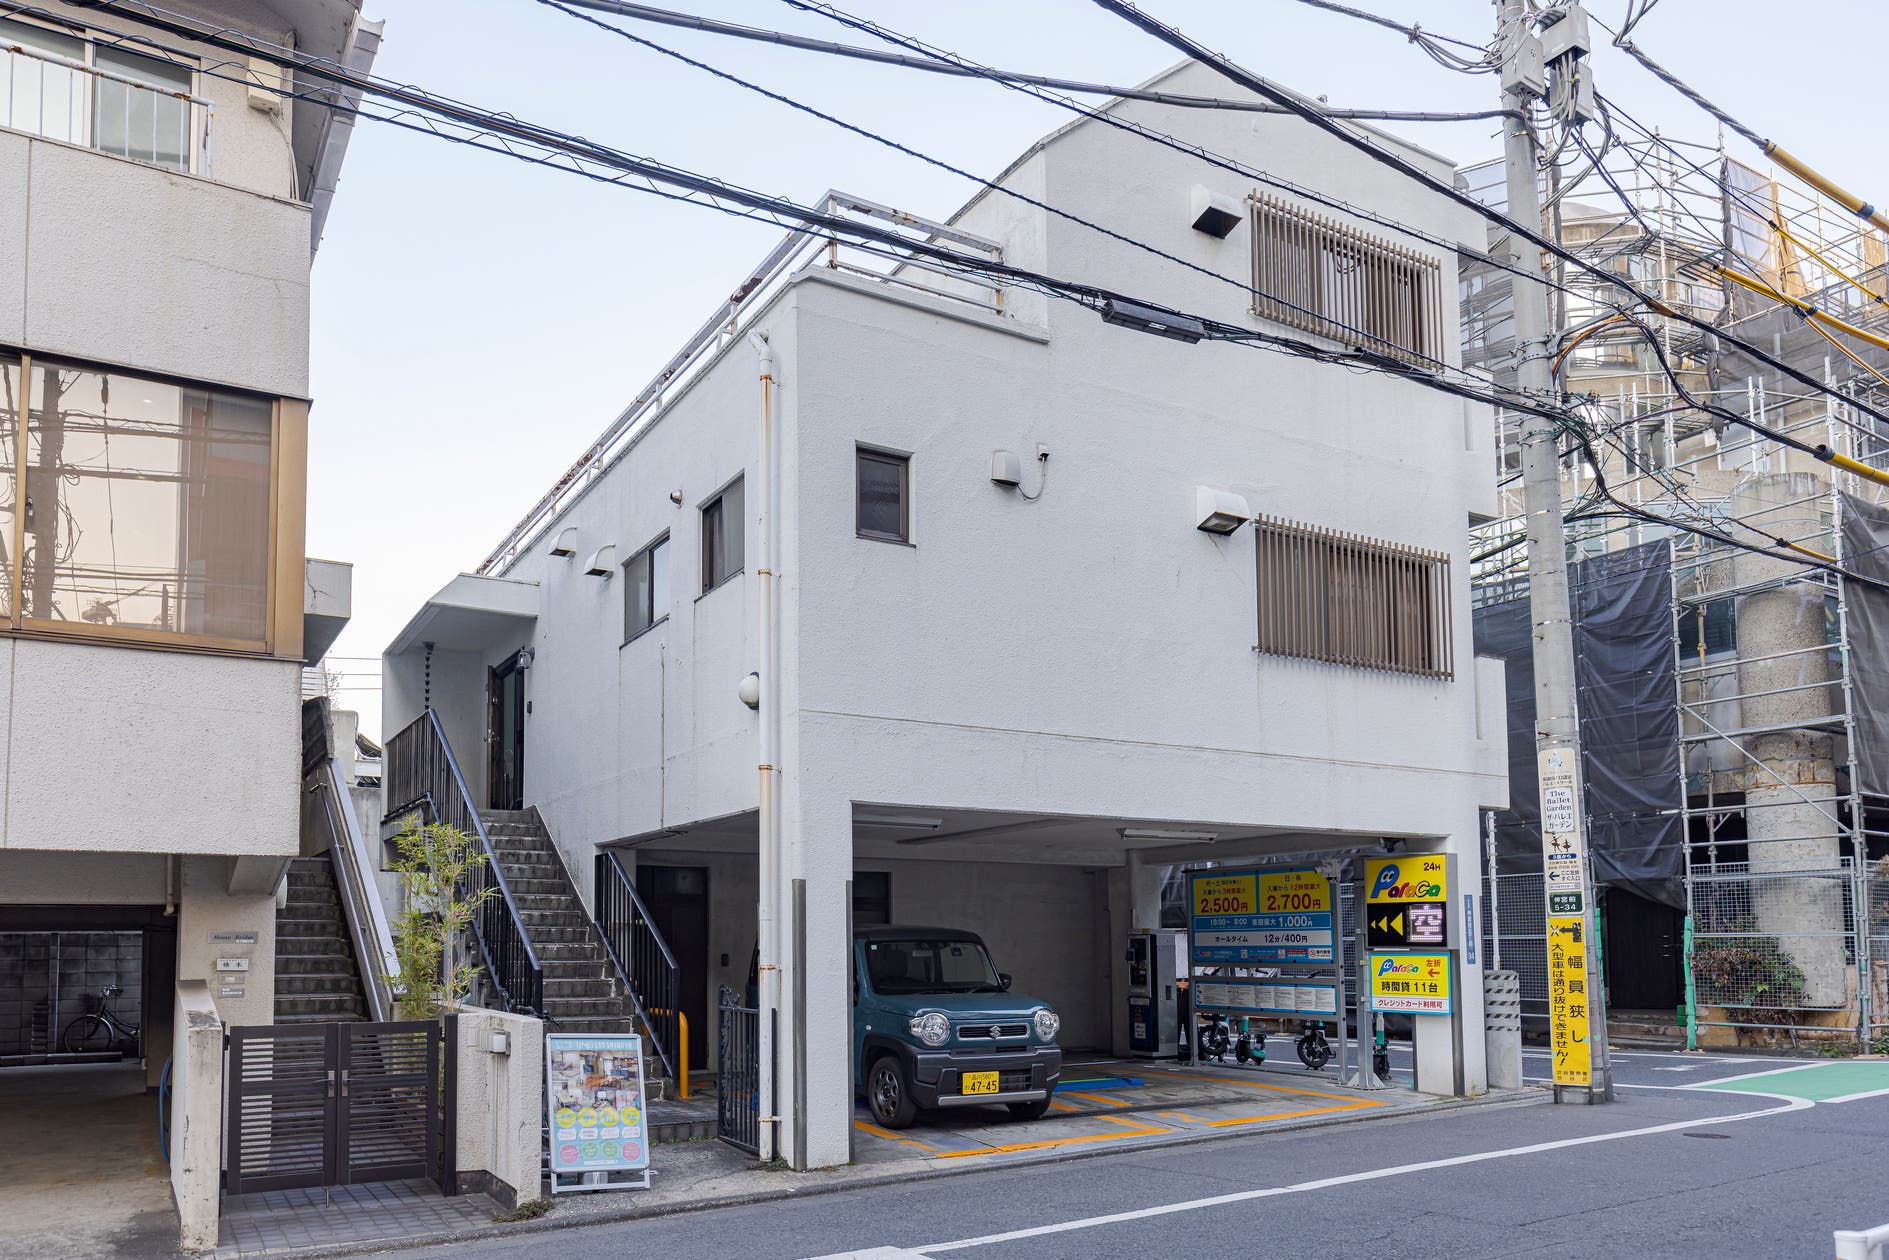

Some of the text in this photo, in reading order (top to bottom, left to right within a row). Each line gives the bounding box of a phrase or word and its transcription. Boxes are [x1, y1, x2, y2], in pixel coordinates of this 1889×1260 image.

[1547, 797, 1570, 805] Ballet
[1549, 821, 1572, 829] ガーデン
[1423, 862, 1441, 871] 24H
[1200, 897, 1248, 913] 2,500円
[1267, 893, 1321, 911] 2,700円
[1410, 904, 1443, 941] 空
[1264, 933, 1308, 943] 12分/400円
[1426, 959, 1441, 967] 左折
[1381, 982, 1438, 993] 時間貸 11台
[1378, 999, 1443, 1008] クレジットカード利用可
[1568, 955, 1585, 1043] 幅員狭し
[971, 1080, 997, 1092] 47-45
